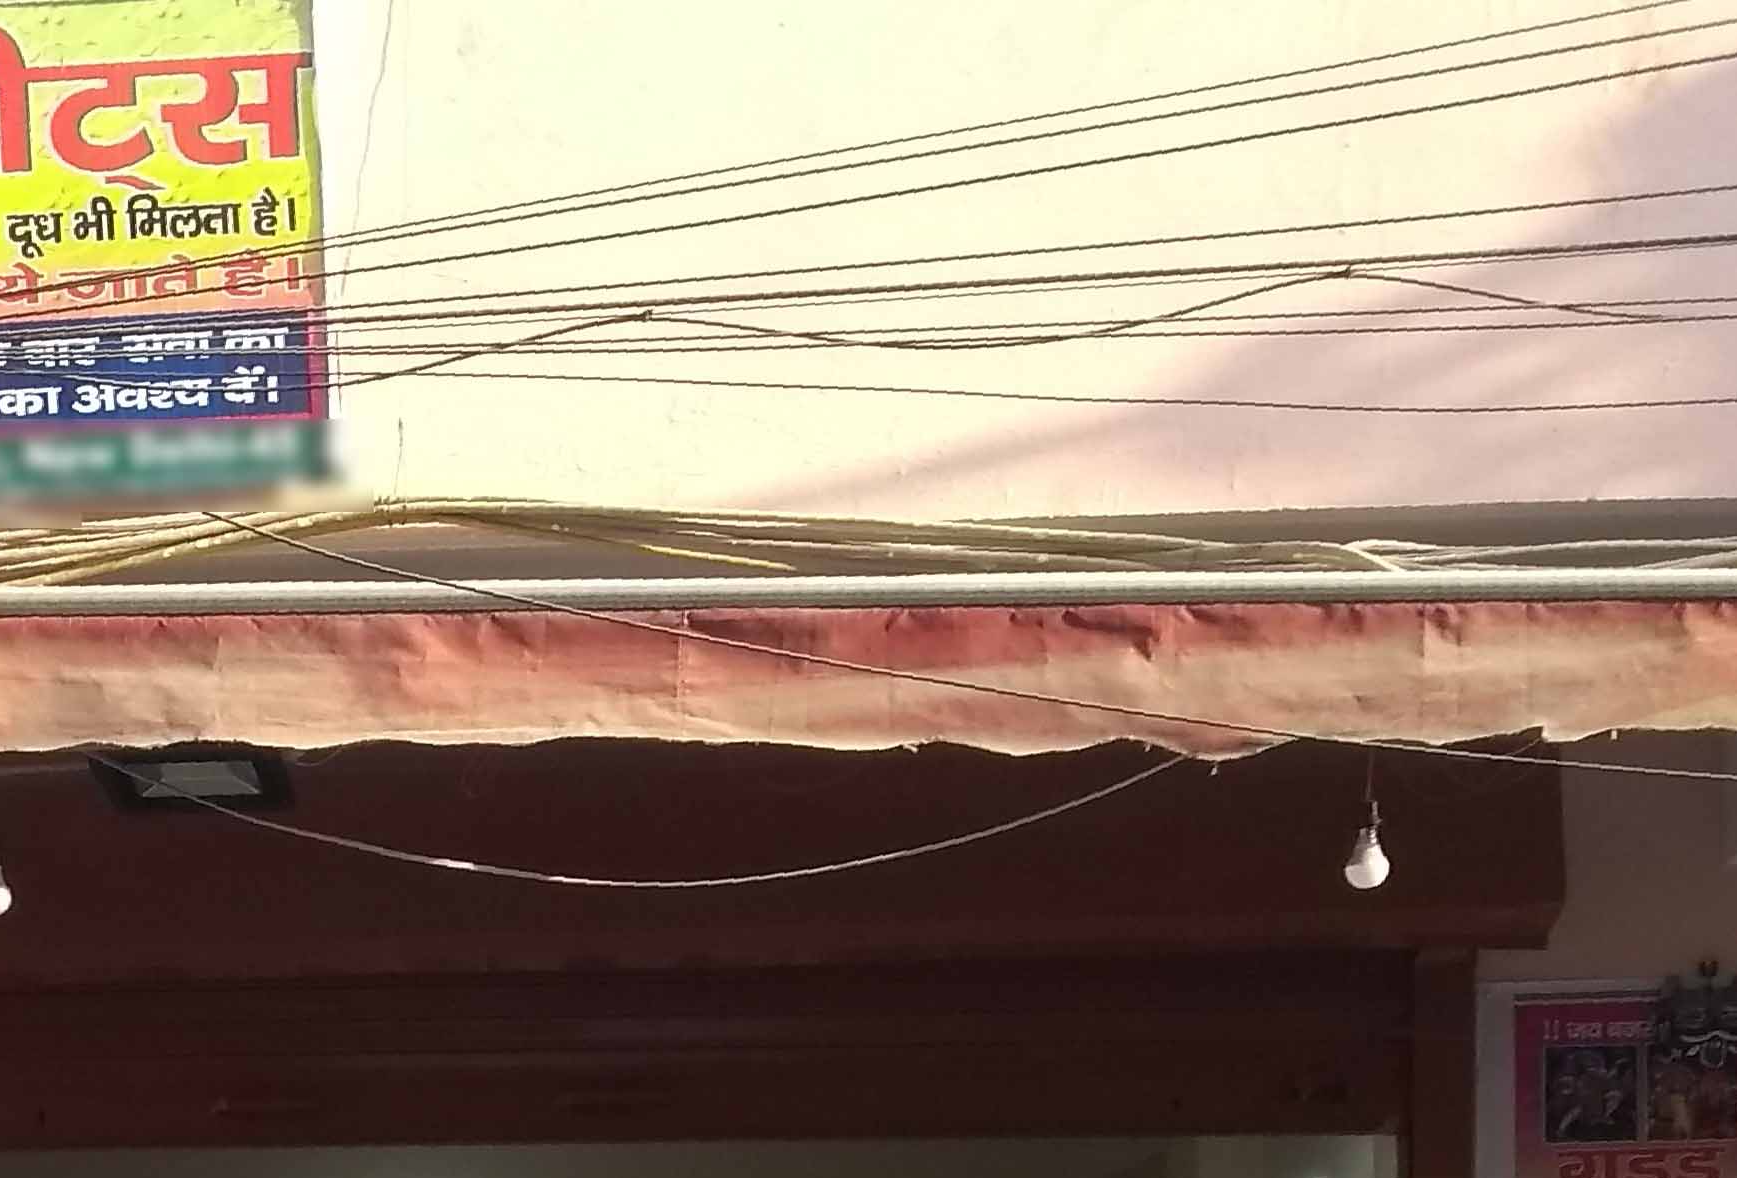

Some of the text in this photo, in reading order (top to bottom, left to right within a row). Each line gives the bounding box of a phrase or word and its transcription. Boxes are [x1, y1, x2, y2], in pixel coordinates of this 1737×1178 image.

[6, 207, 63, 259] दूध
[72, 195, 118, 242] भी
[125, 192, 241, 240] मिलता
[59, 254, 202, 301] जाते
